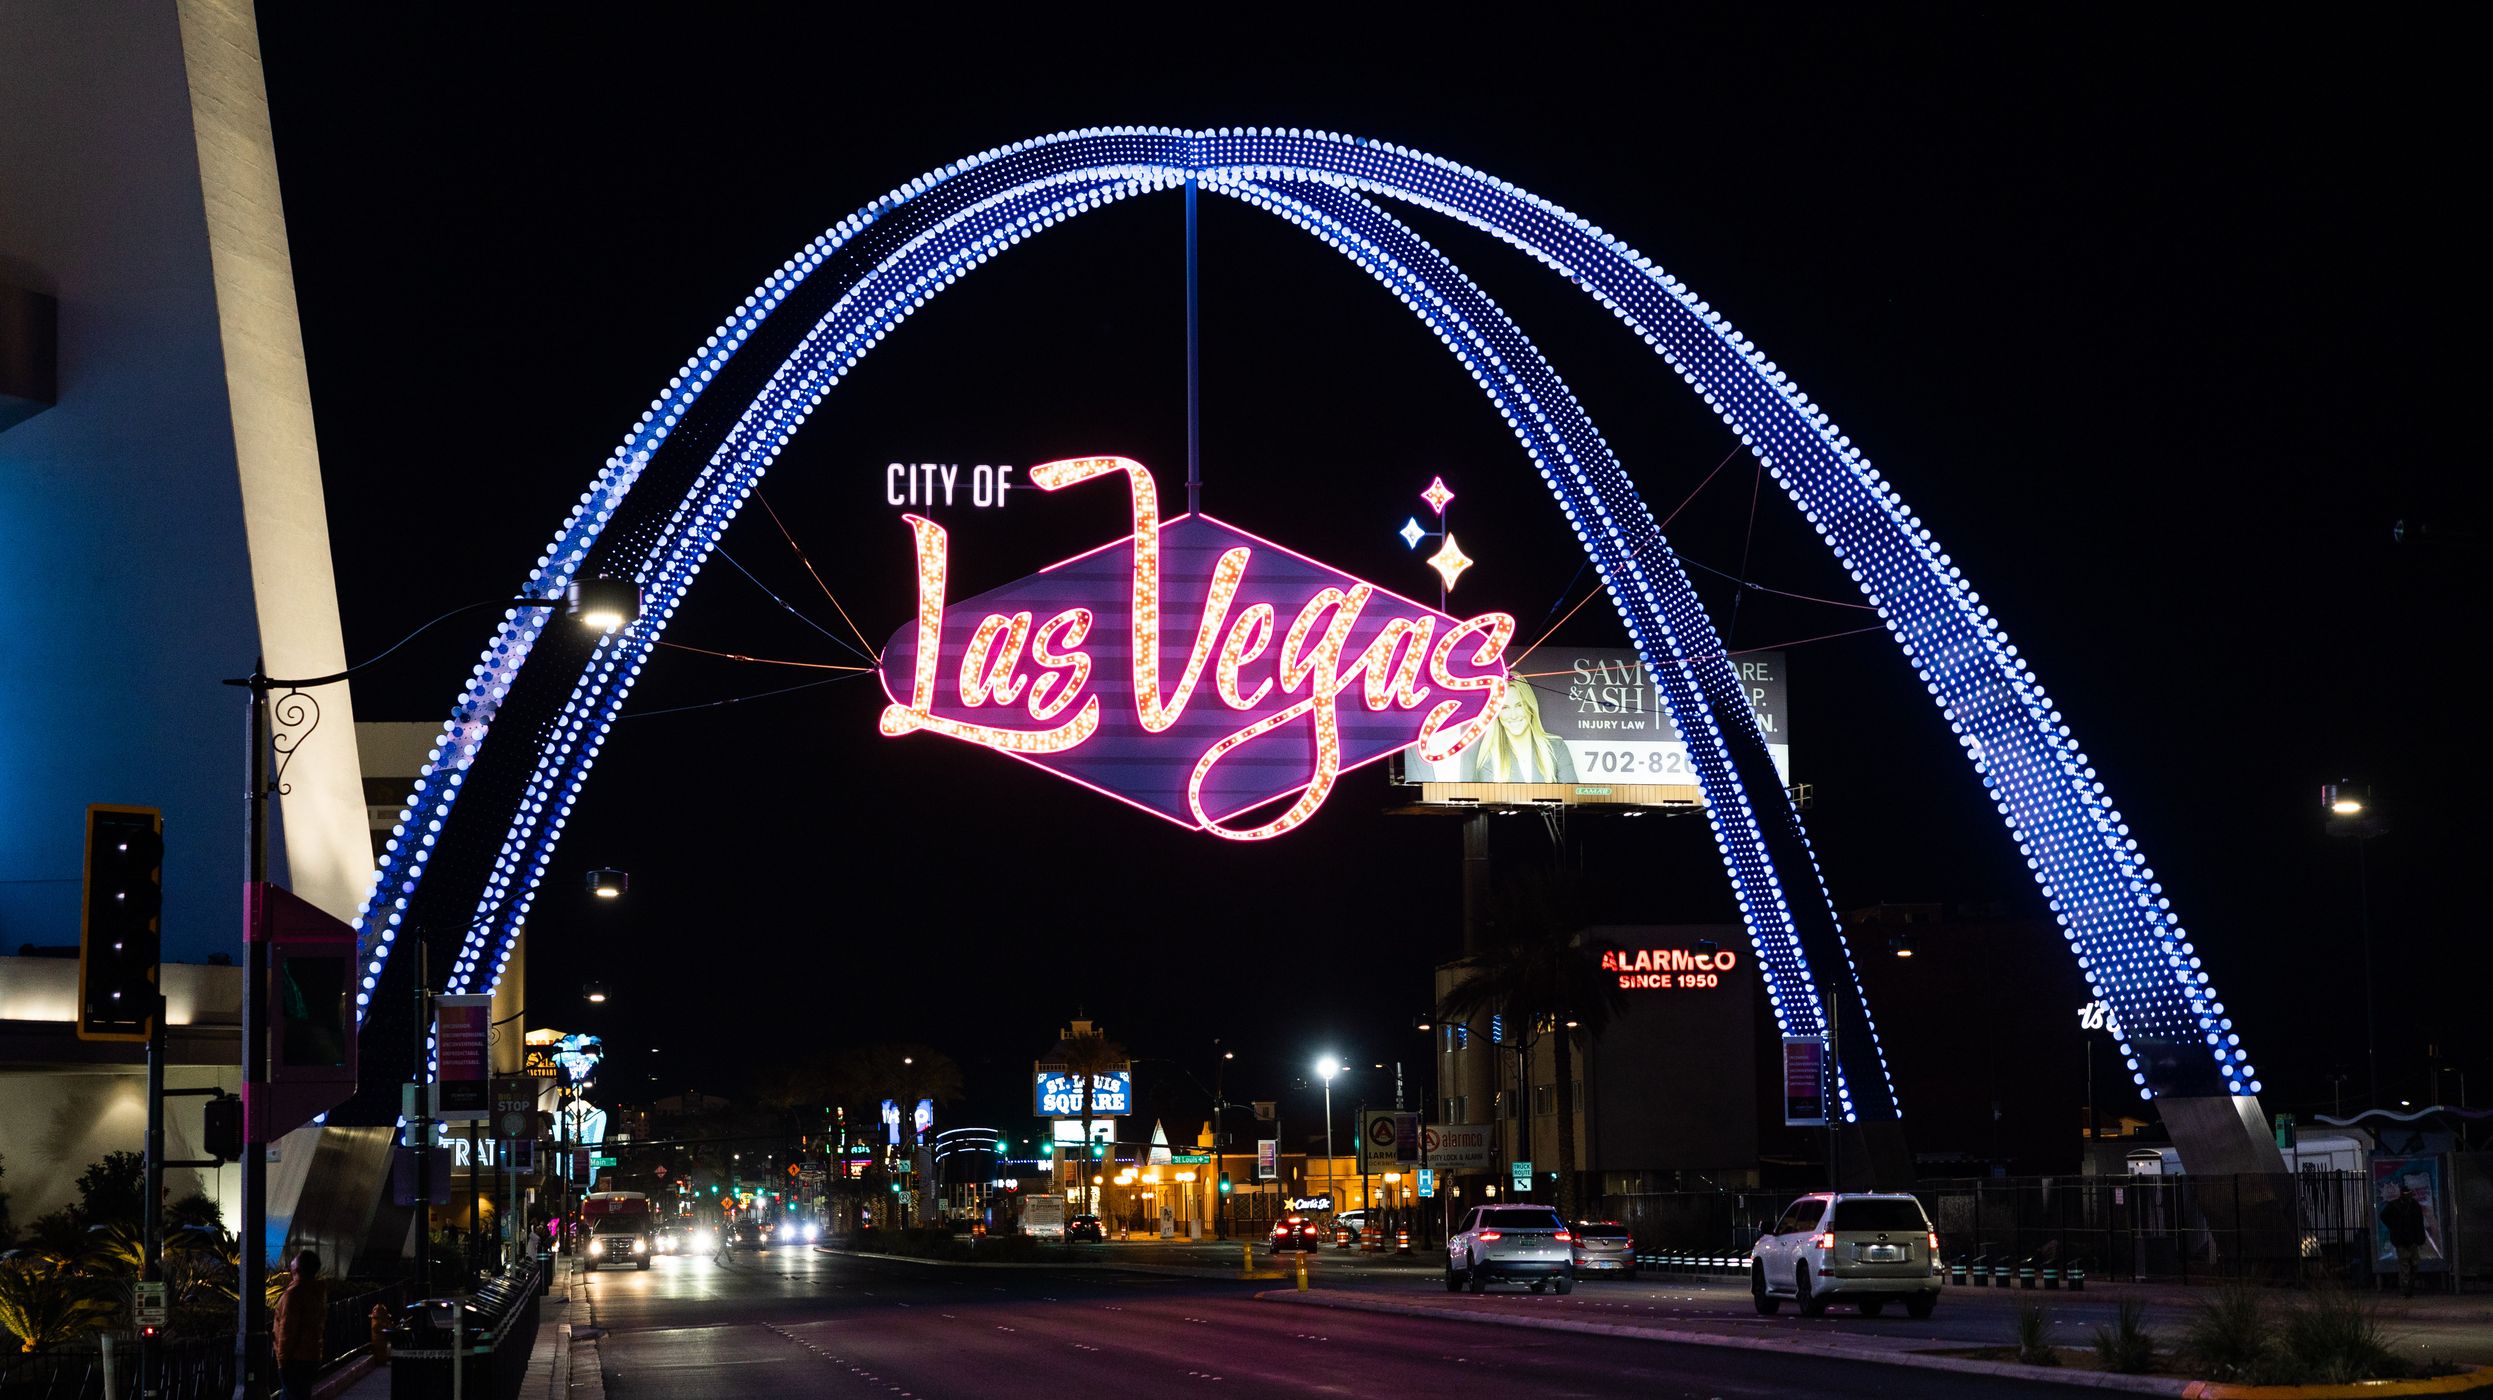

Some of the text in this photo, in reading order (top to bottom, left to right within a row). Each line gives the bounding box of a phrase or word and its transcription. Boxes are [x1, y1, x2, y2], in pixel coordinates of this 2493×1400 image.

[886, 463, 1013, 507] CITY OF
[879, 456, 1517, 841] Las Vegas
[1573, 658, 1645, 687] SAM
[1578, 720, 1645, 730] INJURY LAW
[1601, 949, 1736, 972] ALARMCO
[1619, 974, 1718, 988] SINCE 1950
[1046, 1074, 1121, 1095] ST. LUIS
[497, 1100, 531, 1112] STOP
[1442, 1130, 1484, 1148] alarmco
[591, 1158, 607, 1166] Main
[1182, 1156, 1198, 1164] Louis
[1443, 1153, 1458, 1161] LOCK
[1419, 1169, 1432, 1185] H
[1295, 1198, 1318, 1210] Carl's
